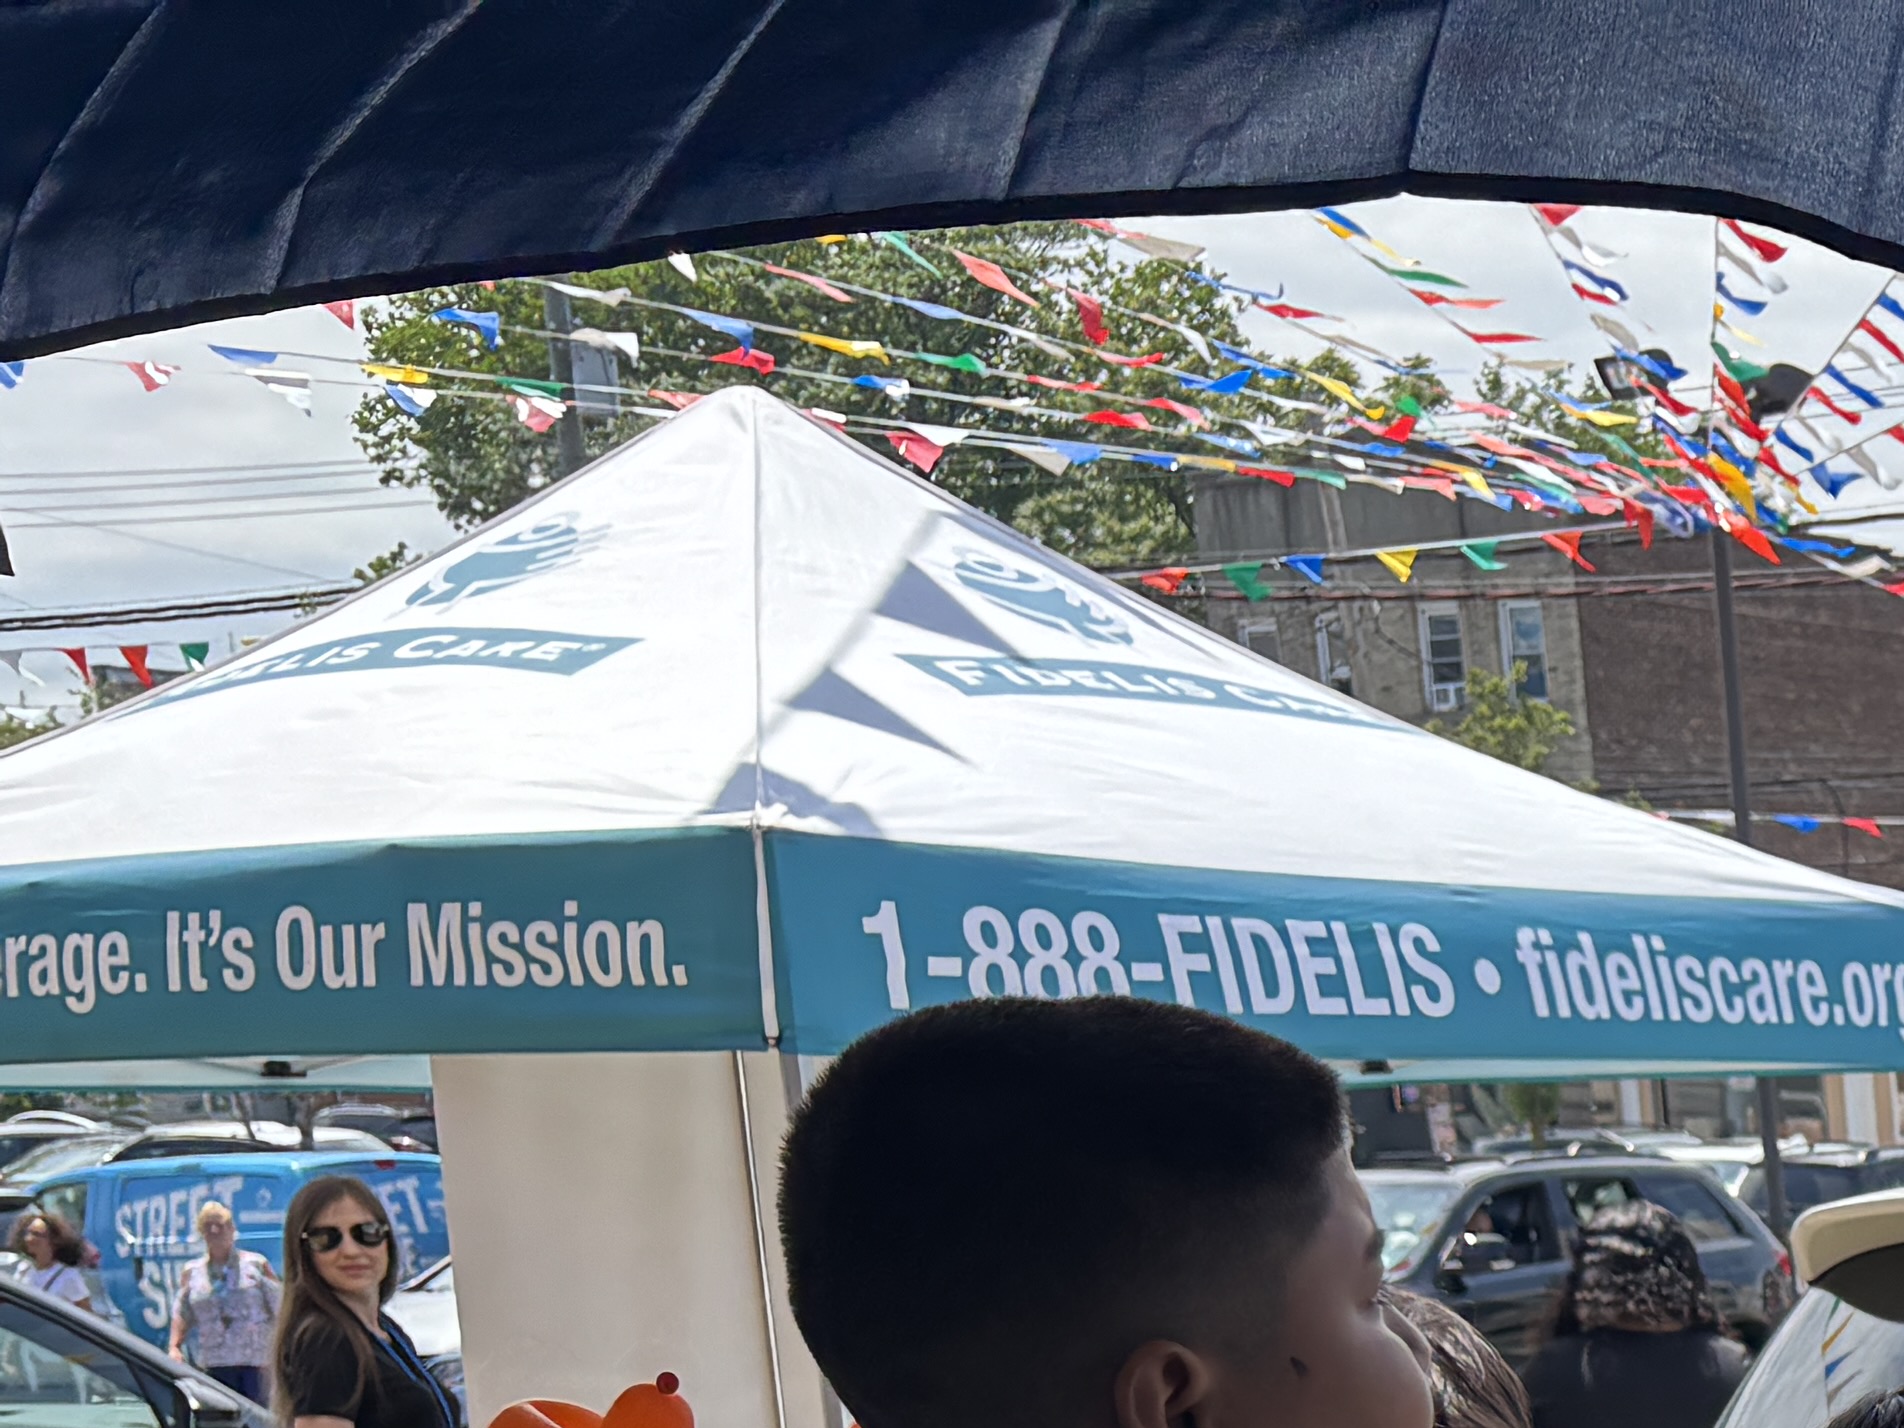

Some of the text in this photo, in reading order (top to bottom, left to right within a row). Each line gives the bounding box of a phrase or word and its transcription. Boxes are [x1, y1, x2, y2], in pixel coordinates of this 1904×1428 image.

[933, 658, 1216, 700] FIDELIS
[0, 899, 689, 1014] rage. It's Our Mission.
[861, 898, 1456, 1018] 1-888-FIDELIS
[114, 1175, 244, 1260] STREET
